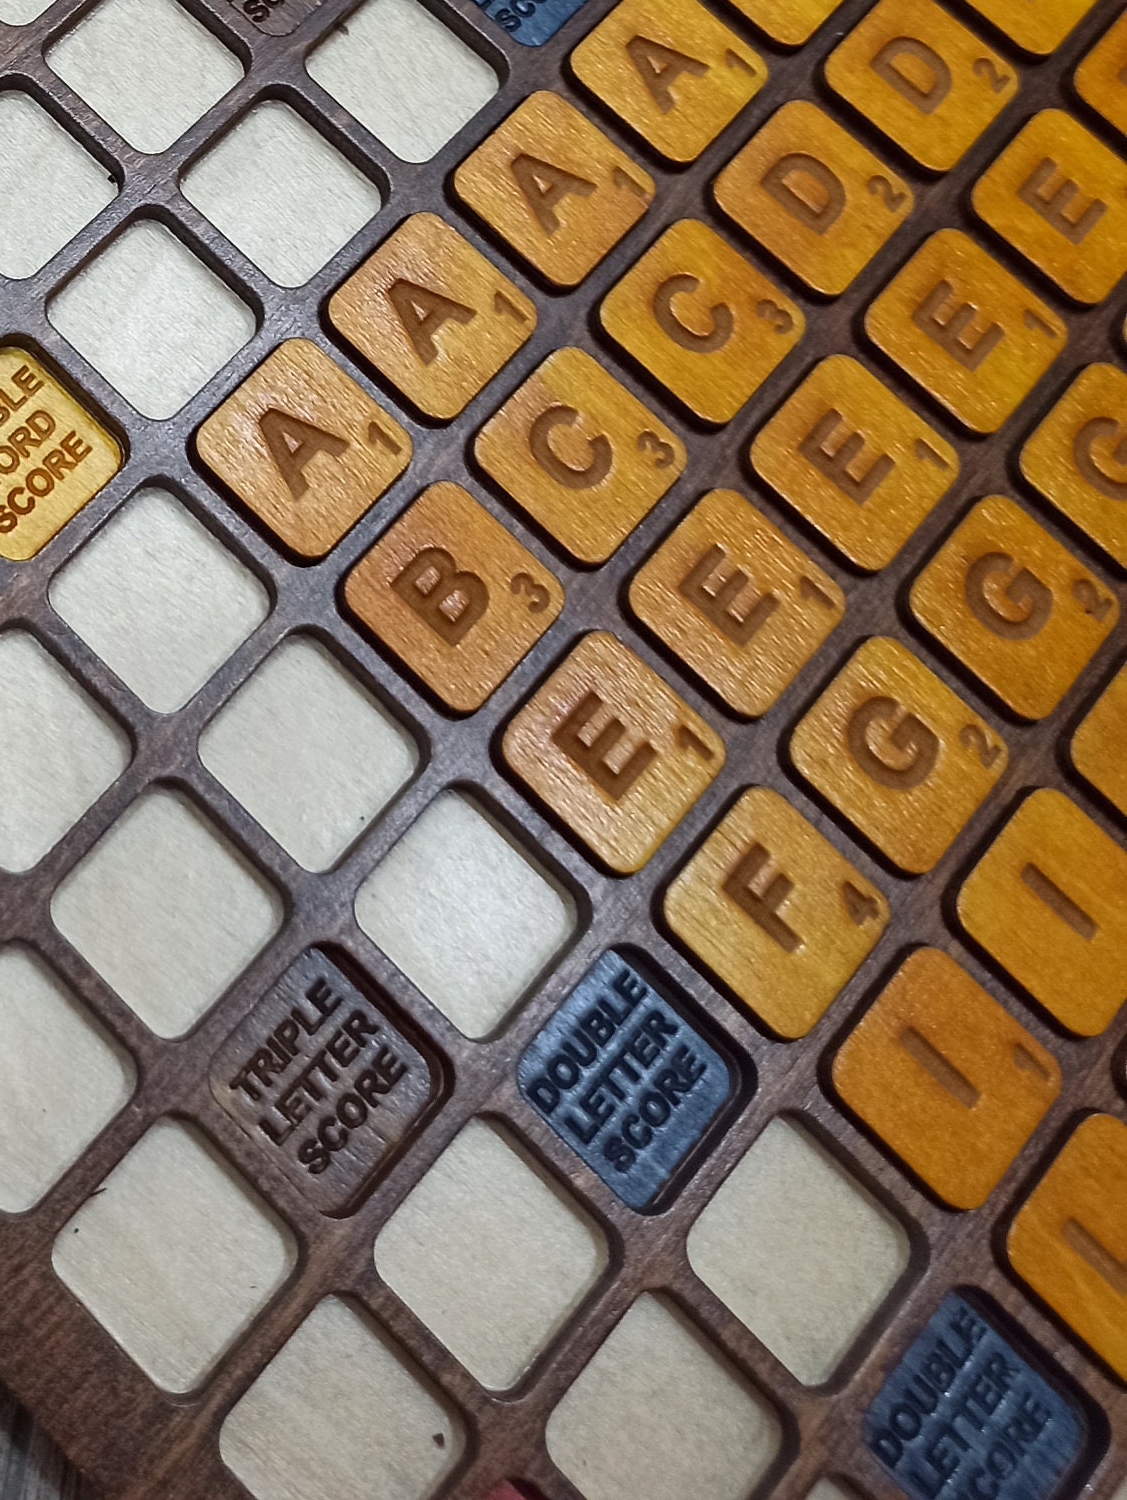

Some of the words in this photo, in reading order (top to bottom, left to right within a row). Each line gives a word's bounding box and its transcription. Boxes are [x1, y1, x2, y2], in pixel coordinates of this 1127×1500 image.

[625, 34, 711, 116] A
[725, 48, 758, 78] 1
[870, 35, 953, 116] D
[973, 57, 1011, 94] 2
[510, 152, 598, 237] A
[612, 165, 648, 199] 1
[760, 152, 847, 236] D
[866, 174, 907, 213] 2
[1017, 156, 1109, 246] E
[388, 277, 478, 366] A
[493, 289, 530, 323] 1
[653, 272, 735, 354] C
[755, 298, 794, 336] 3
[911, 279, 1006, 372] E
[1023, 307, 1059, 340] 1
[258, 407, 350, 501] A
[367, 420, 402, 457] 1
[529, 401, 613, 490] C
[636, 429, 675, 468] 3
[797, 407, 897, 507] E
[914, 437, 950, 470] 1
[391, 546, 491, 648] B
[510, 572, 551, 613] 3
[678, 544, 780, 647] E
[799, 574, 836, 610] 1
[964, 551, 1054, 641] G
[1070, 578, 1113, 622] 2
[551, 690, 658, 803] E
[676, 723, 715, 761] 1
[846, 695, 940, 790] G
[958, 723, 1002, 770] 2
[720, 842, 803, 953] F
[840, 879, 880, 926] 4
[1020, 861, 1099, 941] I
[228, 976, 345, 1101] TRIPLE
[258, 1009, 381, 1147] LETTER
[526, 969, 648, 1116] DOUBLE
[563, 1009, 680, 1146] LETTER
[899, 1025, 981, 1110] I
[1014, 1041, 1051, 1082] 1
[297, 1044, 410, 1175] SCORE
[603, 1044, 709, 1175] SCORE
[872, 1306, 987, 1469] DOUBLE
[960, 1391, 1051, 1500] CORE
